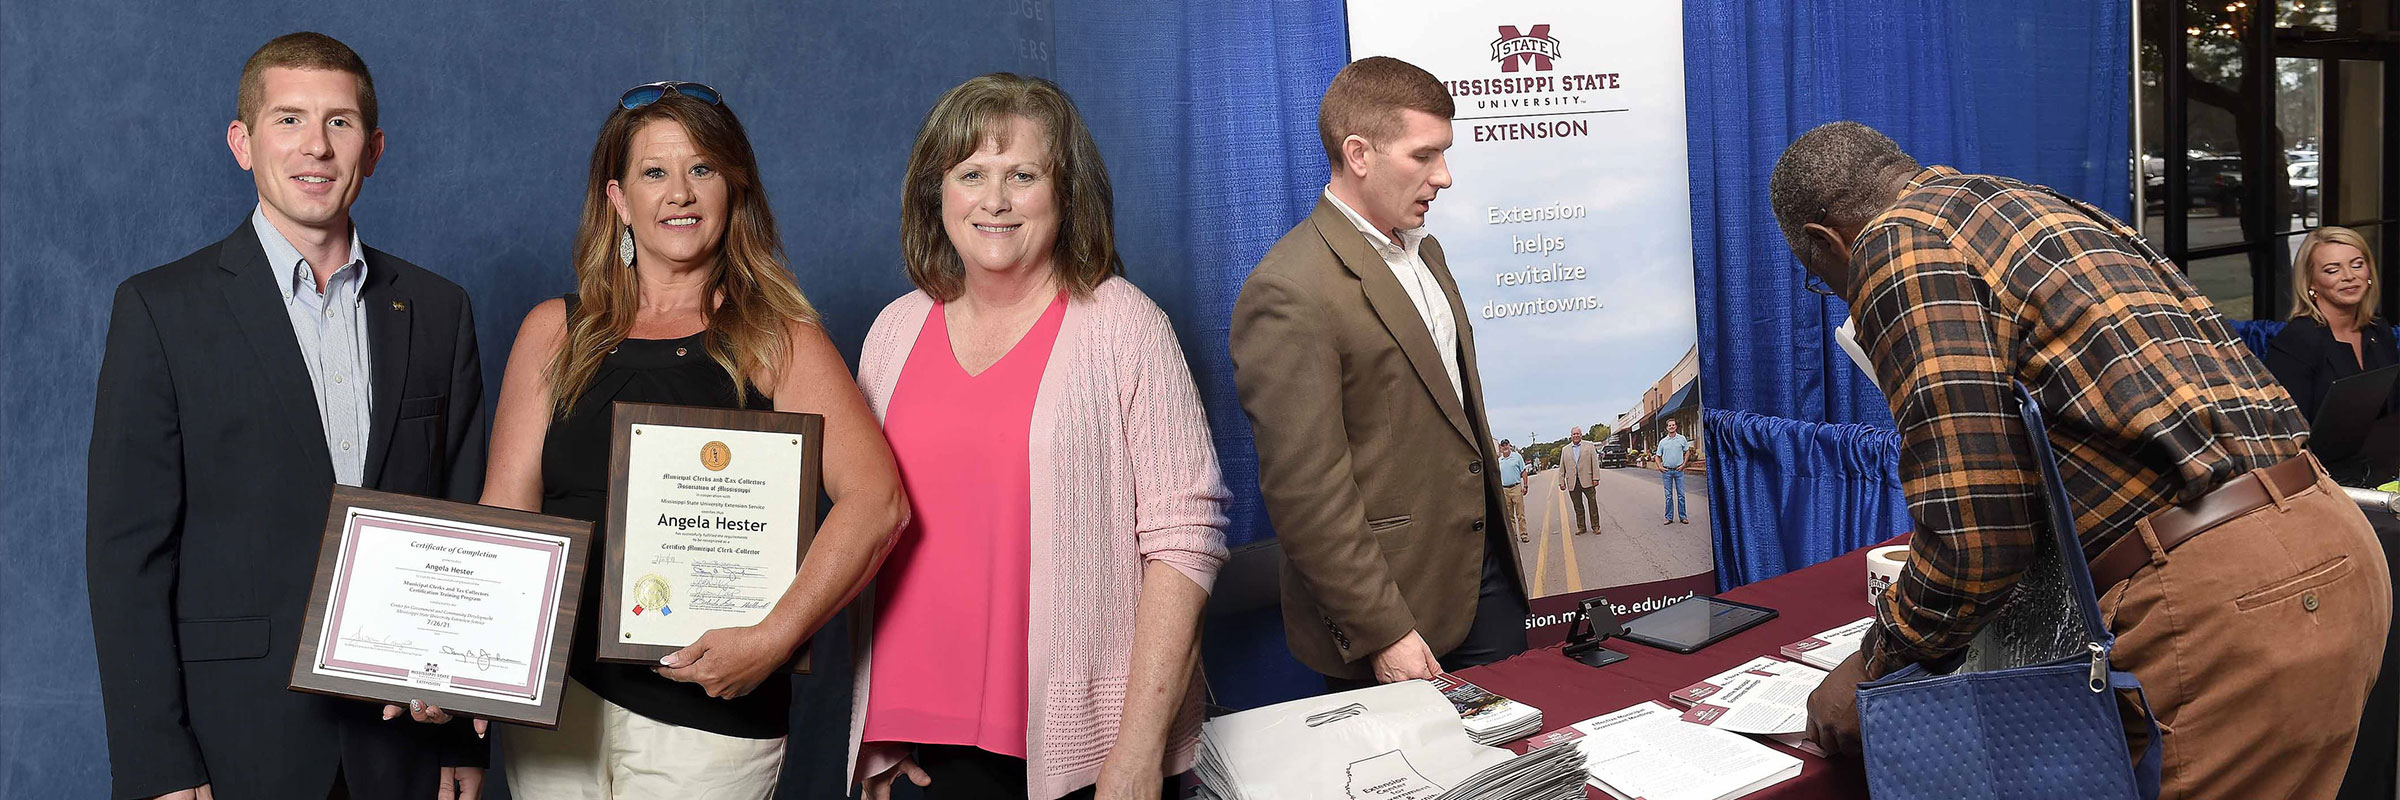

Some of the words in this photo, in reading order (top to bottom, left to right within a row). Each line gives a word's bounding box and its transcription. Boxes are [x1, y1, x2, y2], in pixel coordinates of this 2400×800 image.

[1503, 38, 1549, 55] STATE
[1562, 73, 1620, 92] STATE
[1474, 119, 1588, 143] EXTENSION
[1487, 201, 1586, 224] Extension
[1512, 233, 1565, 257] helps
[1496, 262, 1587, 286] revitalize
[1482, 295, 1604, 319] downtowns.
[677, 483, 709, 491] Association
[717, 485, 751, 494] Mississippi
[738, 478, 766, 486] Collectors
[657, 513, 710, 531] Angela
[716, 516, 767, 532] Hester
[410, 541, 447, 552] Certificate
[448, 546, 457, 554] of
[457, 547, 498, 559] Completion
[661, 543, 686, 551] Certified
[687, 544, 715, 552] Municipal
[425, 563, 449, 572] Angela
[451, 566, 474, 576] Hester
[403, 580, 429, 589] Municipal
[429, 583, 445, 591] Clerks
[465, 589, 489, 597] Collectors
[409, 587, 439, 596] Certification
[440, 591, 460, 600] Training
[426, 619, 450, 628] 7/26/21
[1362, 777, 1408, 794] Extension
[1376, 783, 1406, 794] Center
